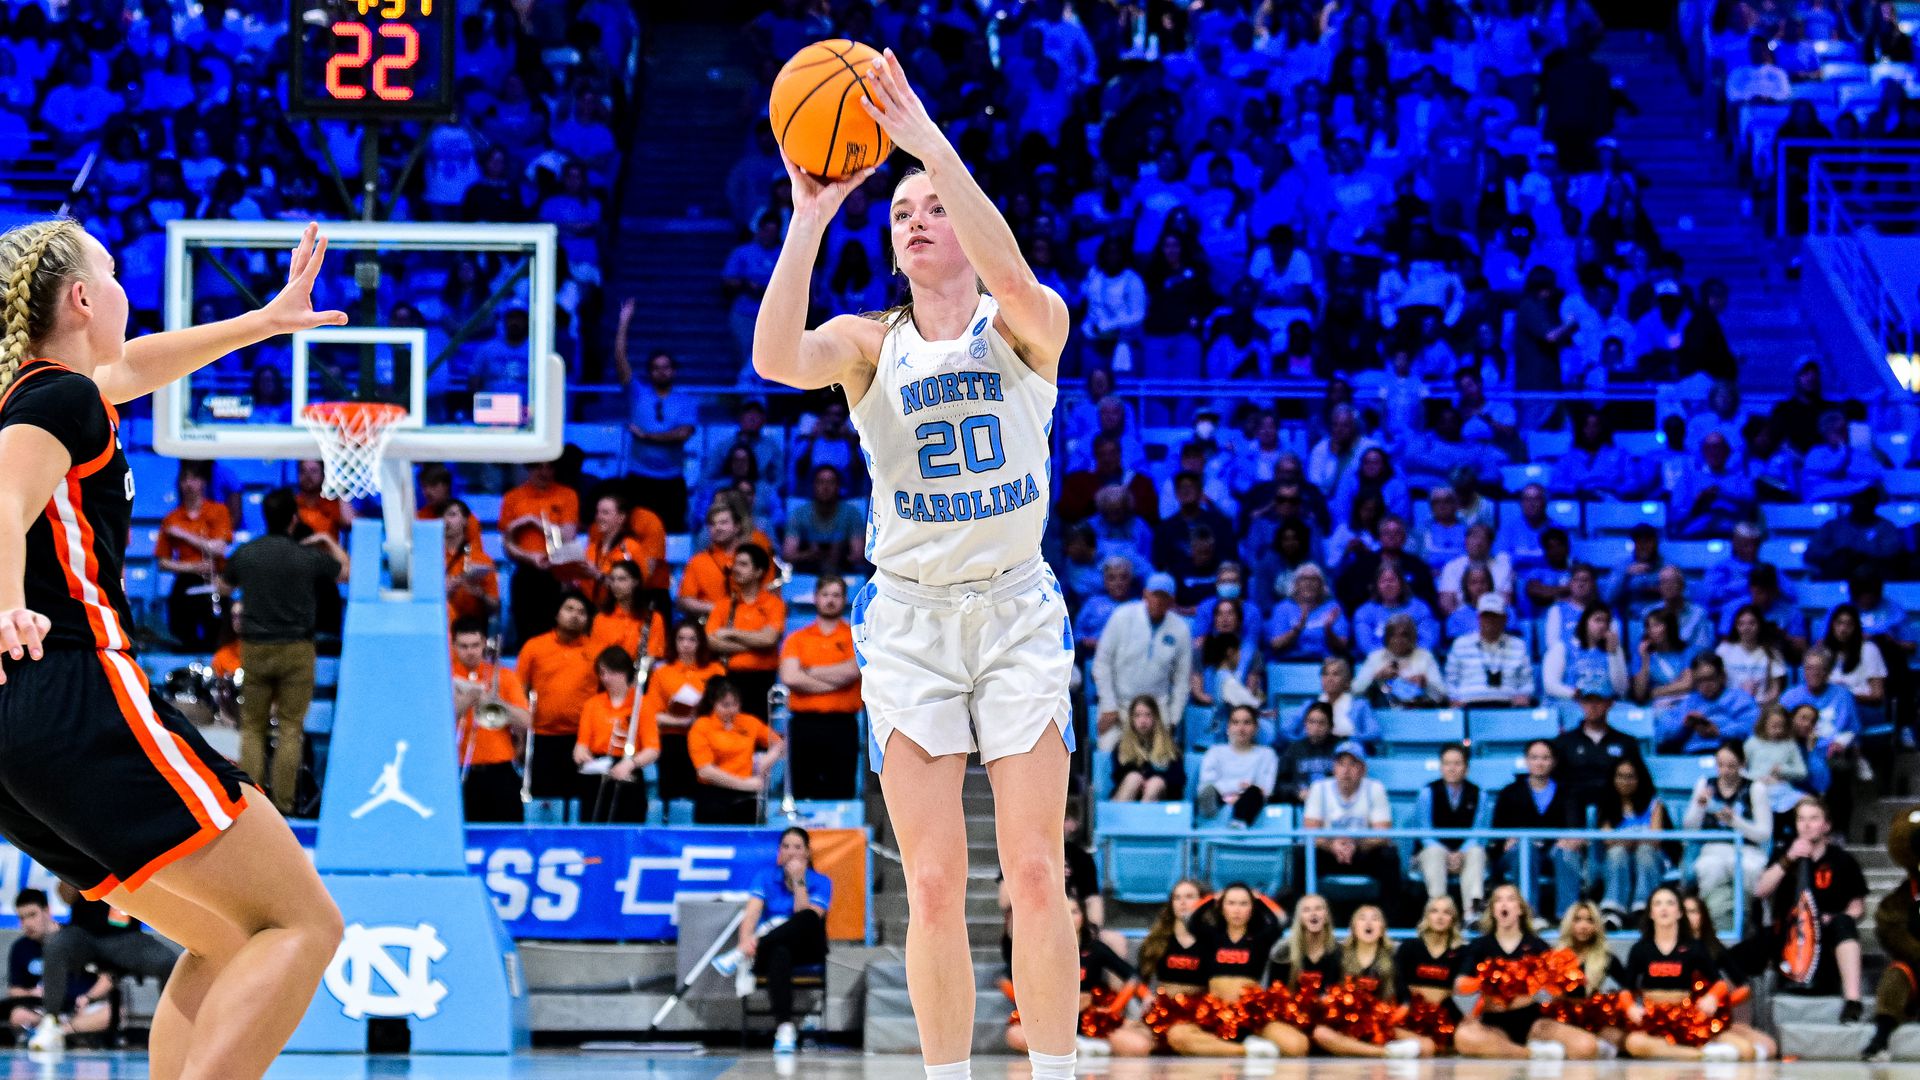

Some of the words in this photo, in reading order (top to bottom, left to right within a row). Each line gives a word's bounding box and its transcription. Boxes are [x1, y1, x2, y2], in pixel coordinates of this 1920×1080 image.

[326, 22, 419, 100] 22
[900, 371, 1004, 415] NORTH
[915, 414, 1006, 479] 20
[895, 473, 1039, 522] CAROLINA
